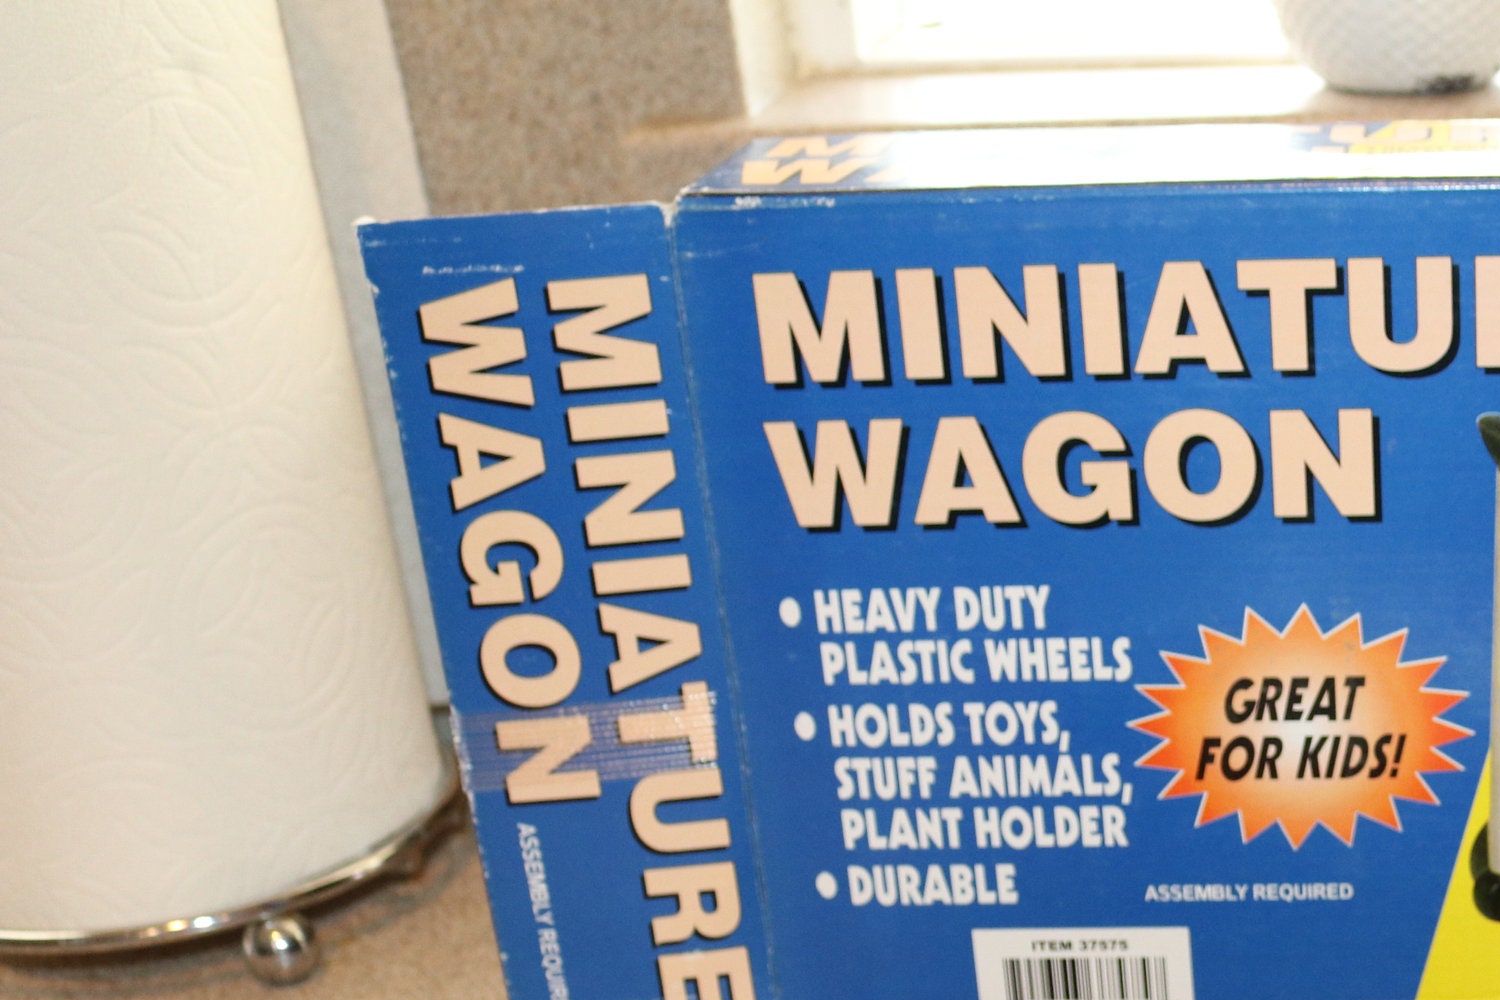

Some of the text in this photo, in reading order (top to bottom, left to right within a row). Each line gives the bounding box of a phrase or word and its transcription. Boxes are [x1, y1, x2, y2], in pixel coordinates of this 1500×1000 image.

[762, 408, 1382, 532] WAGON
[417, 277, 602, 806] WAGON
[813, 585, 1050, 634] HEAVY DUTY
[820, 637, 1134, 686] PLASTIC WHEELS
[1224, 676, 1366, 724] GREAT
[827, 700, 1071, 753] HOLDS TOYS,
[834, 752, 1133, 805] STUFF ANIMALS,
[1195, 734, 1407, 781] FOR KIDS!
[841, 805, 1129, 851] PLANT HOLDER
[516, 821, 555, 926] ASSEMBLY
[847, 864, 1019, 907] DURABLE
[1145, 882, 1355, 903] ASSEMBLY REQUIRED
[1031, 939, 1129, 951] ITEM 37575
